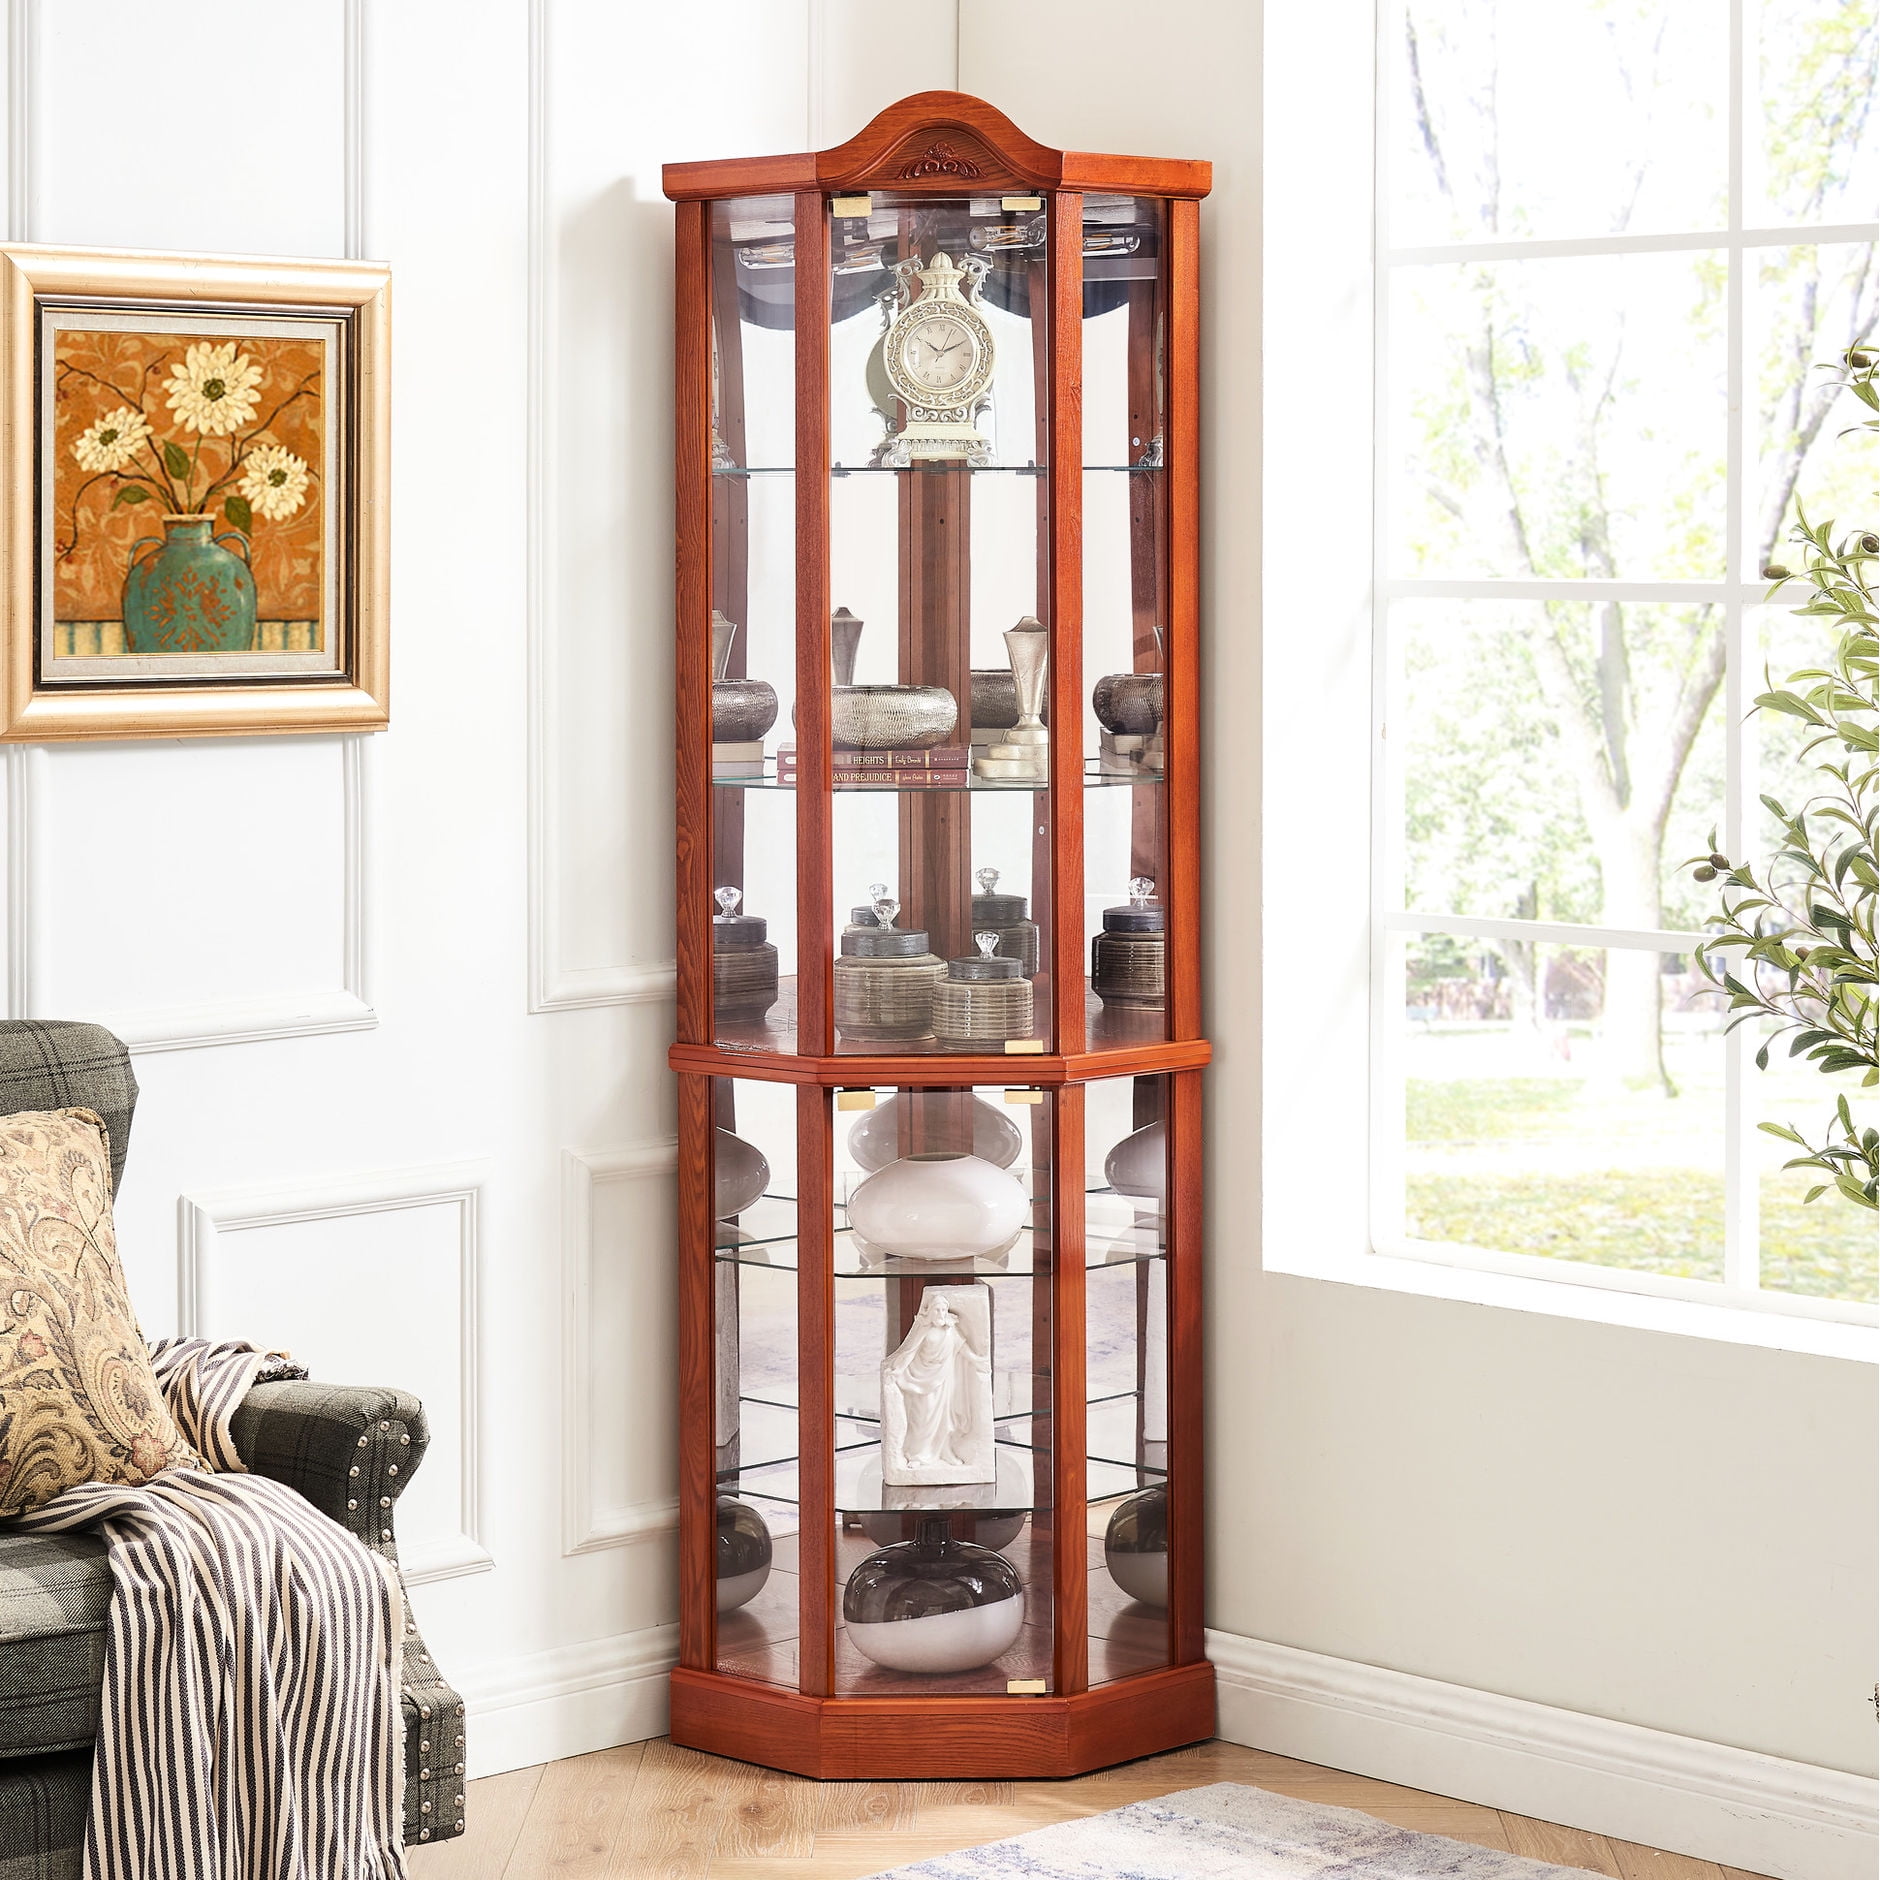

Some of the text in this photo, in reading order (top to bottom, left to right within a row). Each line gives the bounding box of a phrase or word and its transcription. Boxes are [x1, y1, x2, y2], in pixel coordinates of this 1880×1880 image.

[853, 756, 884, 764] HEIGHTS
[833, 773, 849, 782] AND
[850, 772, 892, 782] PREJUDICE
